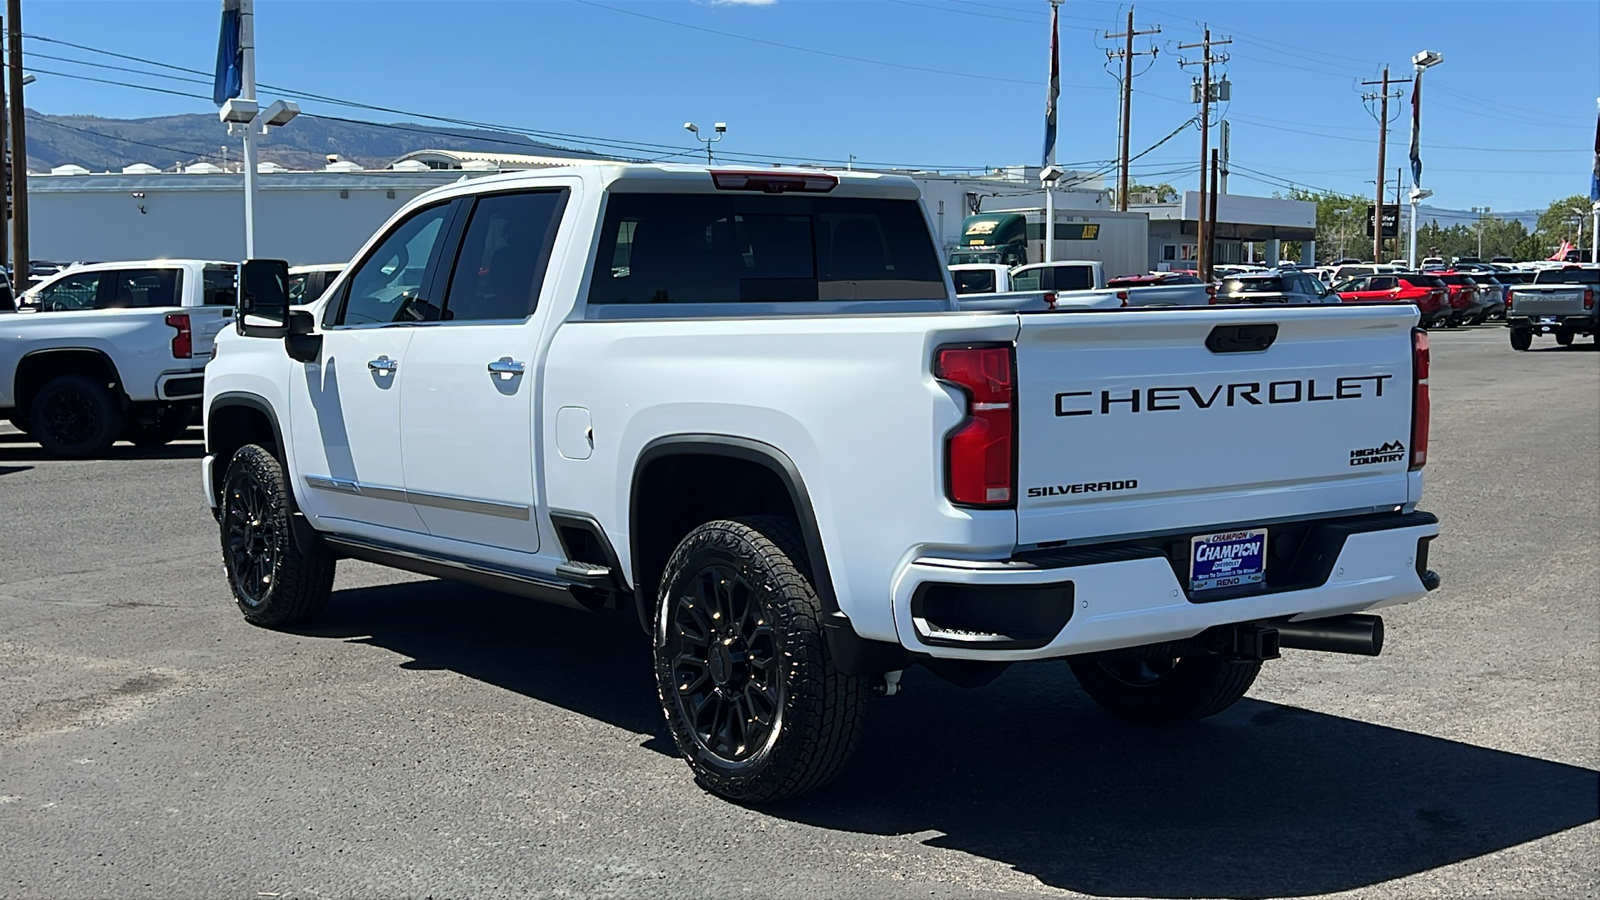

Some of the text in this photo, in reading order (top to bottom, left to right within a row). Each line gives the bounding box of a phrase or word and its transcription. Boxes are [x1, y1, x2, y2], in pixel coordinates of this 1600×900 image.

[1082, 225, 1098, 239] ABF
[1055, 375, 1392, 417] CHEVROLET
[1350, 448, 1381, 458] HIGH
[1350, 453, 1405, 466] COUNTRY
[1028, 479, 1138, 497] SILVERADO
[1212, 531, 1248, 542] CHAMPION
[1196, 542, 1260, 562] CHAMPION
[1216, 578, 1240, 586] RENO
